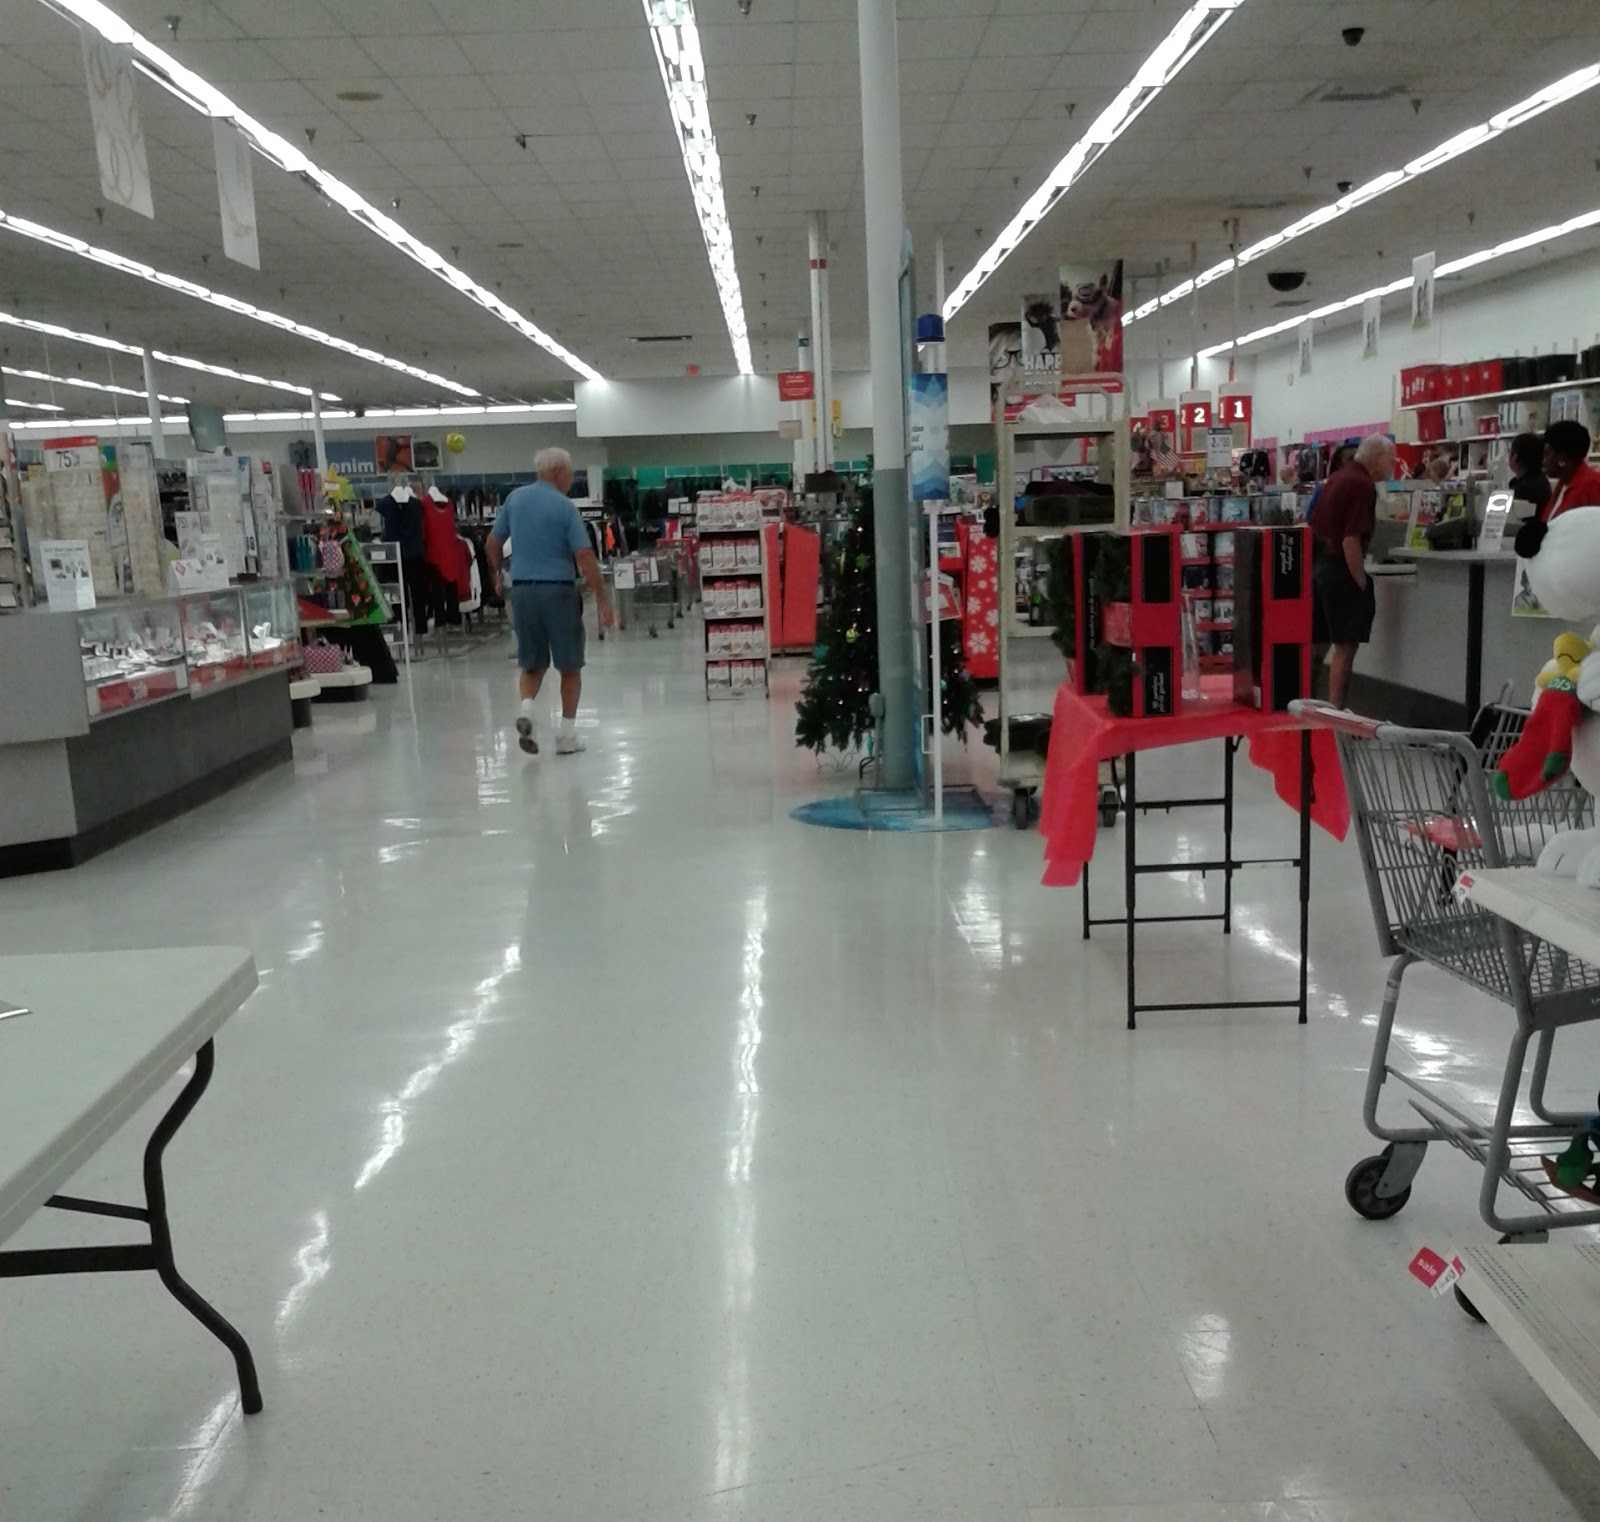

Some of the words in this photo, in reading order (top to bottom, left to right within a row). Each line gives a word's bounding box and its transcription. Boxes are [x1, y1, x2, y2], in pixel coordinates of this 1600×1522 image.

[1193, 406, 1206, 424] 2
[1233, 400, 1245, 419] 1
[1160, 414, 1169, 428] 3
[330, 457, 375, 474] enim
[1417, 1257, 1437, 1277] sale
